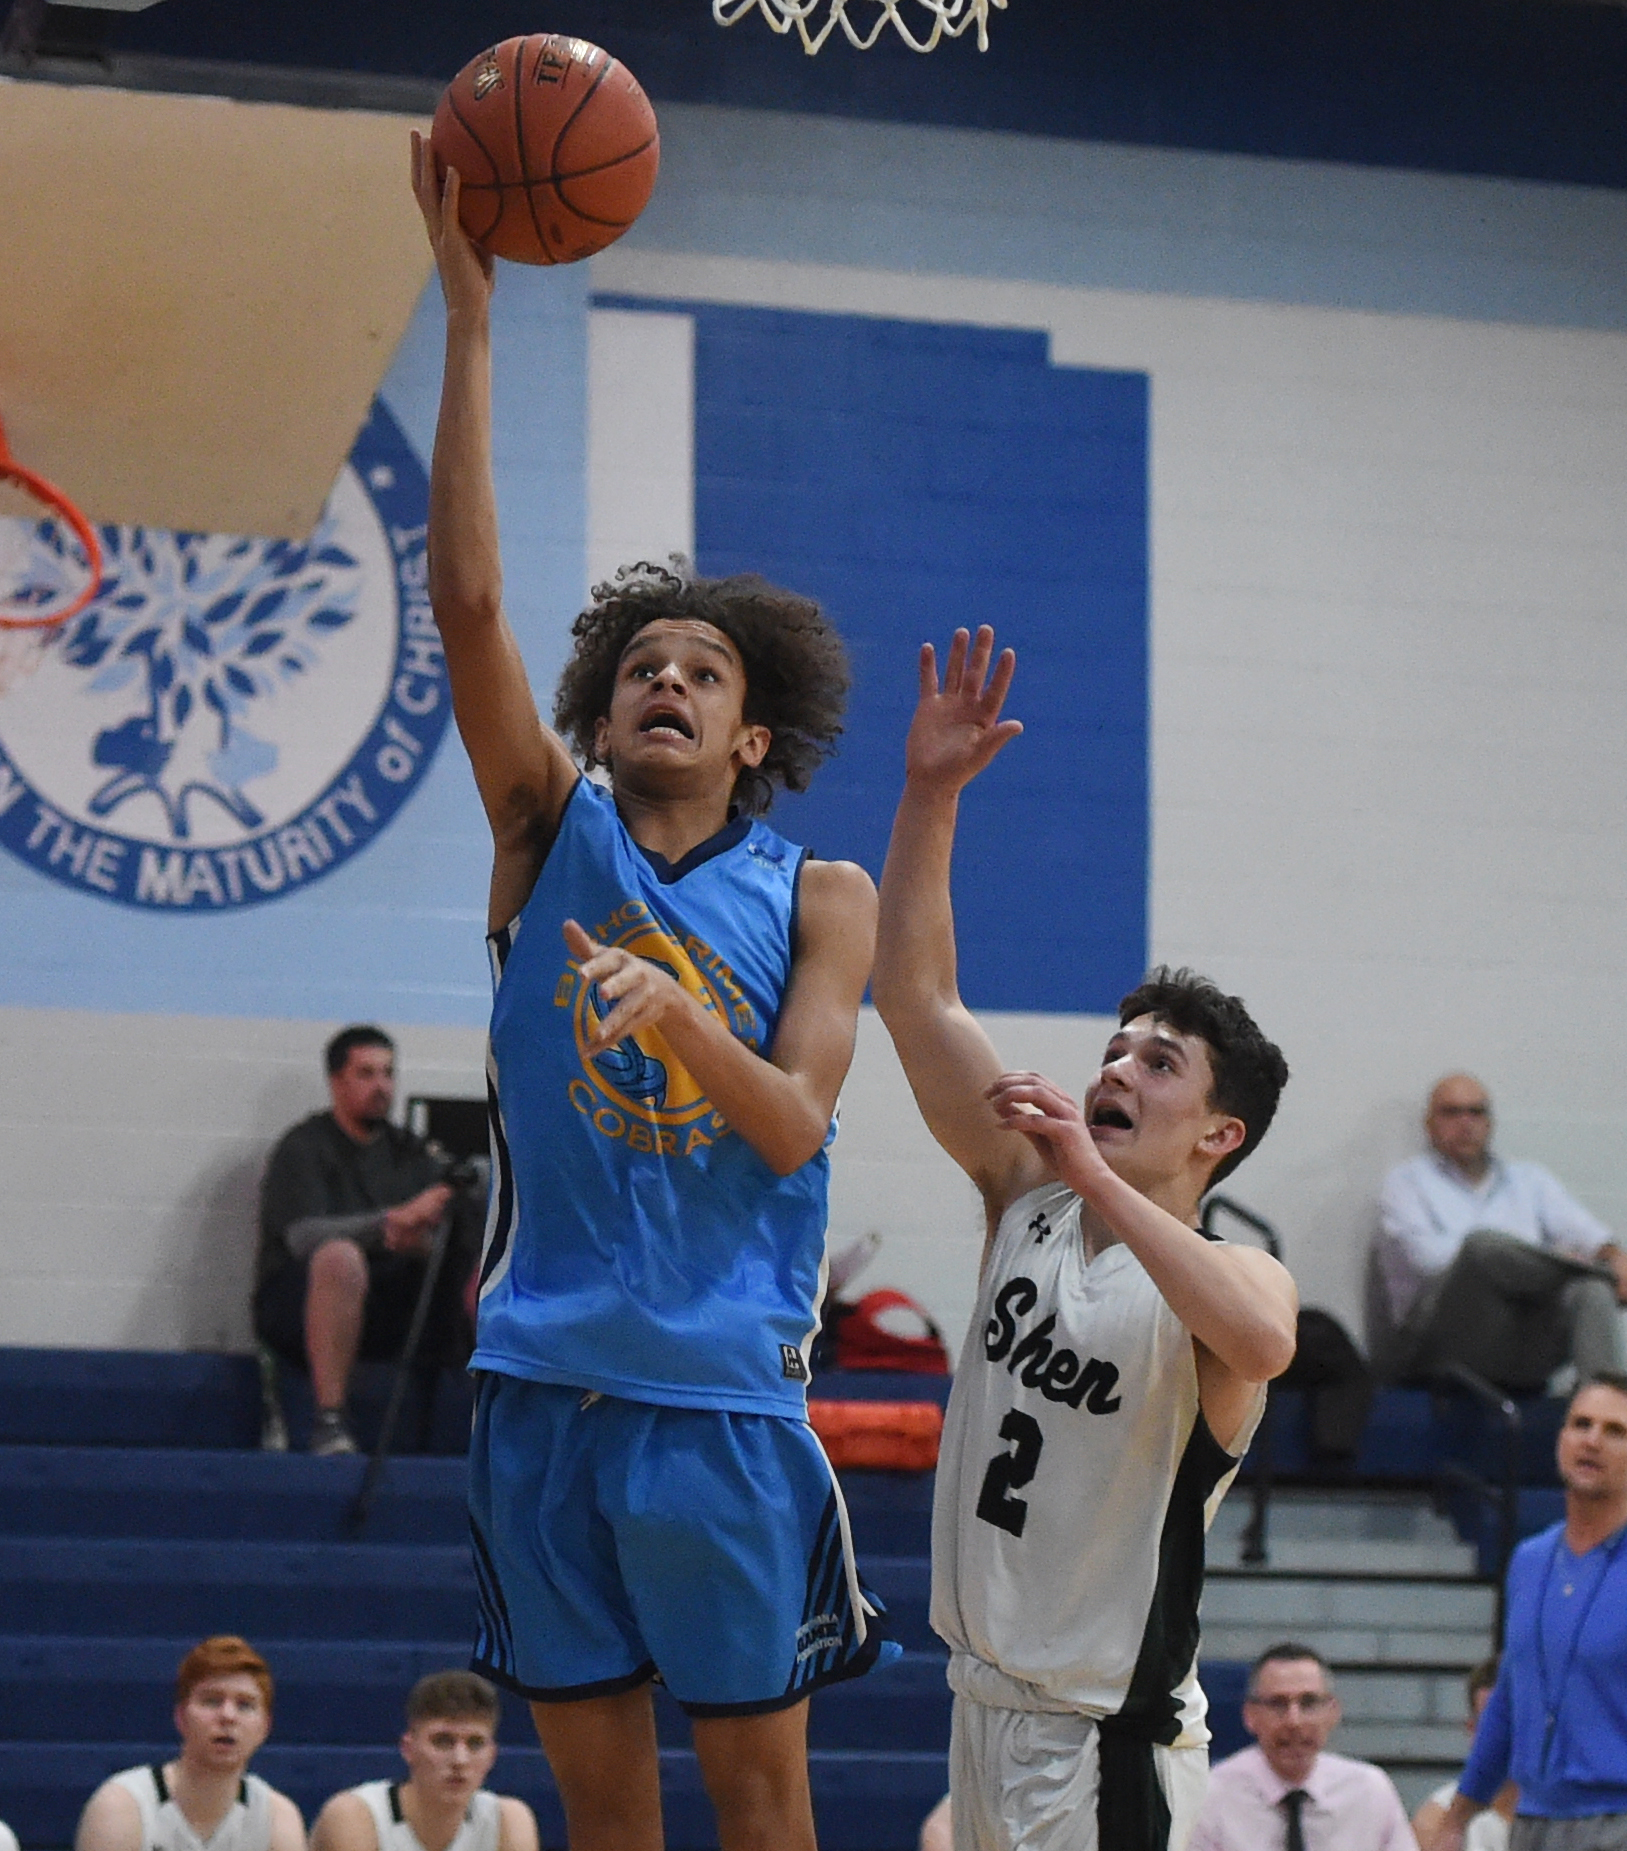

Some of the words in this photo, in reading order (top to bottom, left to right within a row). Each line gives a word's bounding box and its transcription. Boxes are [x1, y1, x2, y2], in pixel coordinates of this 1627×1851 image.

[26, 806, 128, 892] THE
[136, 774, 380, 906] MATURITY
[568, 1079, 733, 1157] COBRAS
[985, 1277, 1122, 1415] Shen
[976, 1407, 1043, 1538] 2
